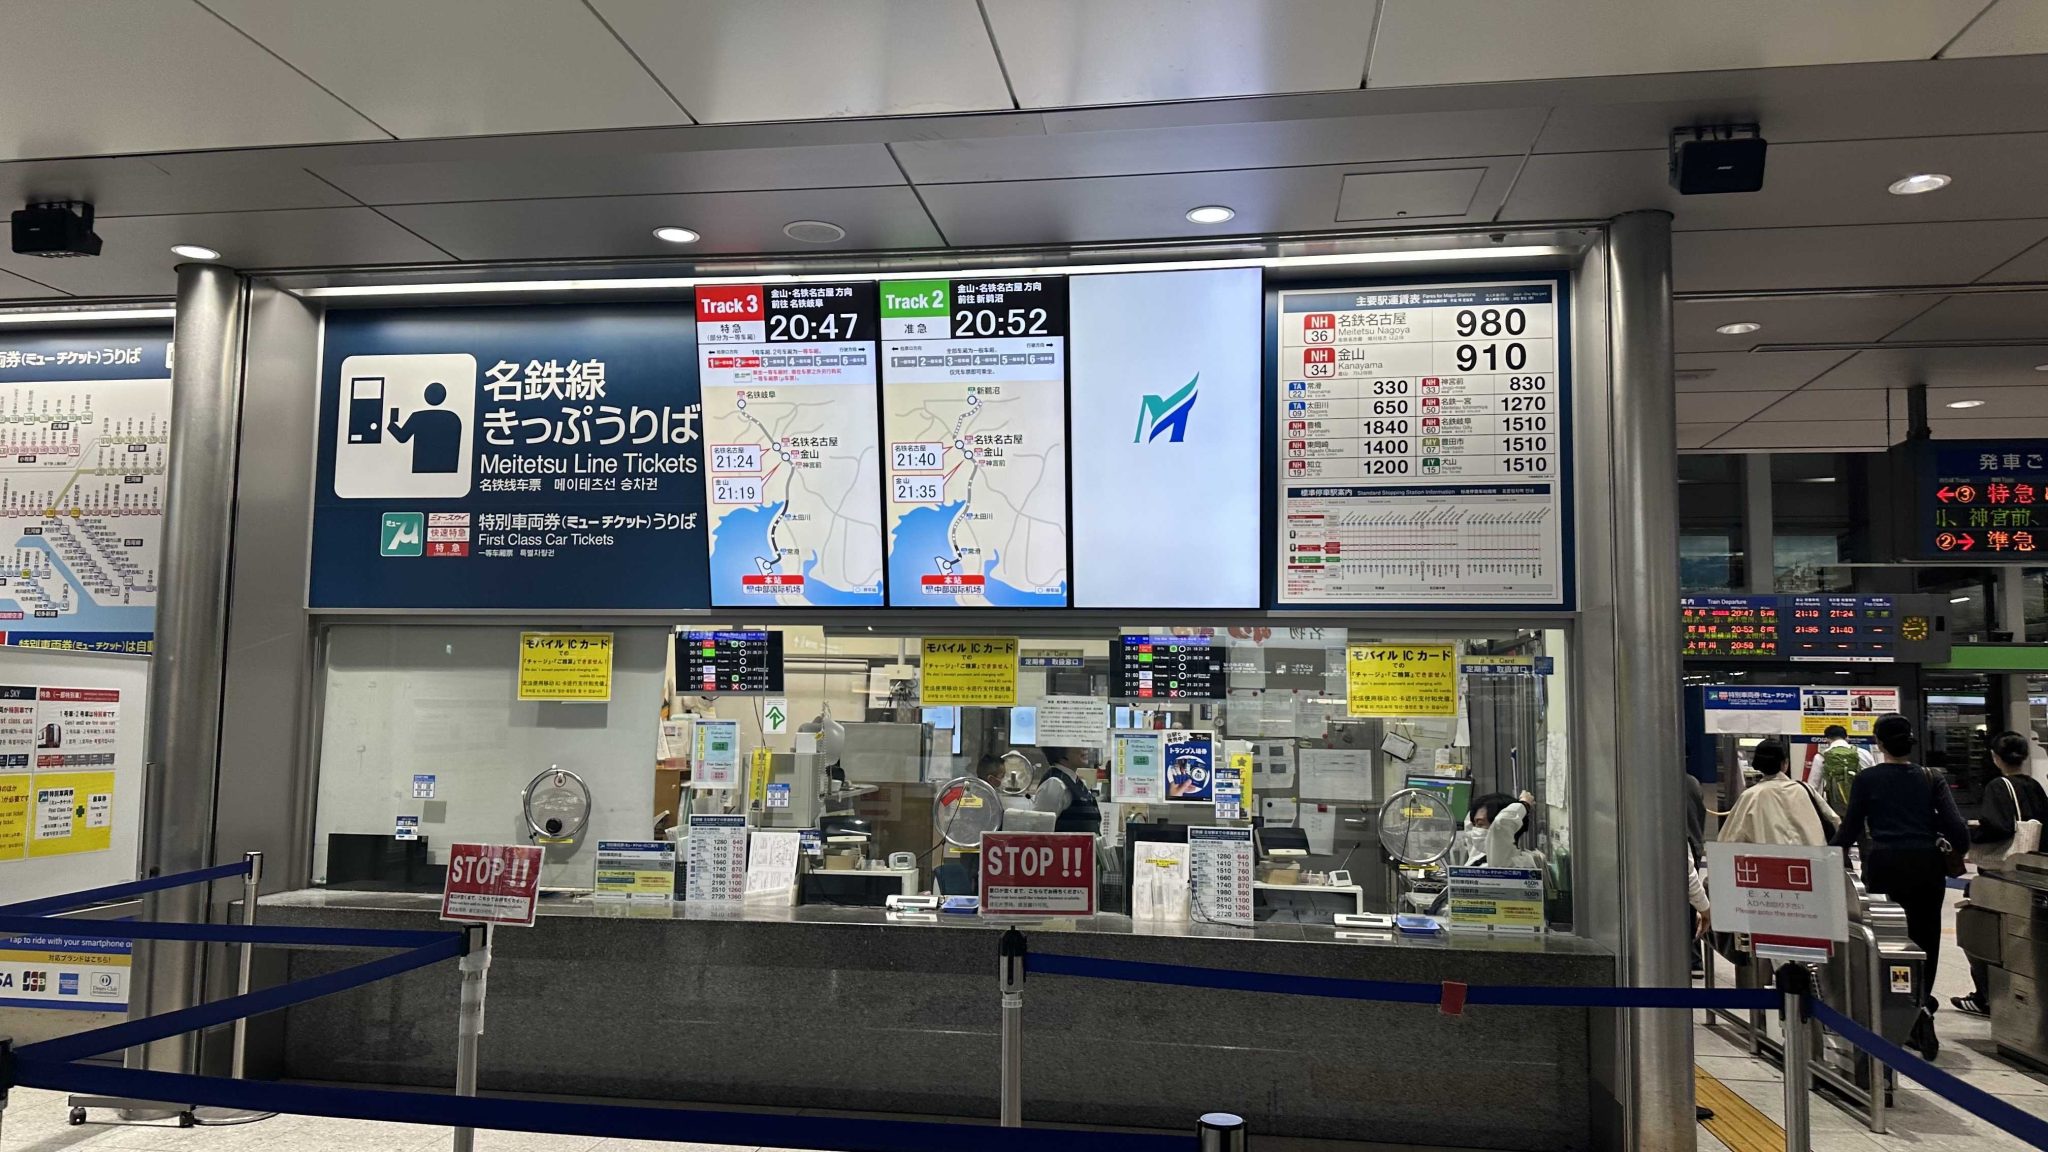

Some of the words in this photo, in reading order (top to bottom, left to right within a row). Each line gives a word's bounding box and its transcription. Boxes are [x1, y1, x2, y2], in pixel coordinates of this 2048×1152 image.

[835, 287, 852, 297] 方向
[1024, 282, 1042, 292] 方向
[701, 297, 743, 313] Track
[746, 294, 758, 313] 3
[771, 299, 789, 308] 前往
[886, 294, 929, 309] Track
[932, 290, 944, 308] 2
[957, 295, 975, 304] 前往
[1356, 294, 1420, 307] 主要駅運賃表
[955, 308, 1048, 336] 20:52
[1311, 316, 1328, 328] NH
[1338, 312, 1407, 327] 名鉄名古屋
[1457, 308, 1526, 338] 980
[720, 324, 742, 333] 特急
[770, 313, 858, 341] 20:47
[904, 323, 928, 334] 准急
[1338, 327, 1375, 336] Meitetsu
[1377, 326, 1410, 335] Nagoya
[1312, 331, 1328, 341] 36
[1311, 350, 1328, 362] NH
[1338, 347, 1365, 361] 金山
[1457, 343, 1526, 371] 910
[1312, 364, 1327, 376] 34
[1338, 361, 1383, 370] Kanayama
[483, 359, 606, 401] 名鉄線
[1510, 376, 1545, 391] 830
[1373, 380, 1408, 395] 330
[1293, 402, 1302, 410] TA
[1373, 400, 1408, 414] 650
[1501, 396, 1546, 411] 1270
[483, 403, 701, 445] きっぷうりば
[1364, 420, 1408, 434] 1840
[1503, 417, 1546, 431] 1510
[791, 437, 838, 447] 名铁名古屋
[974, 435, 1023, 445] 名铁名古屋
[1503, 437, 1547, 452] 1510
[984, 448, 1003, 457] 金山
[1364, 440, 1408, 454] 1400
[716, 455, 753, 468] 21:24
[800, 450, 819, 460] 金山
[897, 453, 936, 466] 21:40
[1980, 453, 2043, 470] 発車ご
[480, 453, 567, 474] Meitetsu
[575, 453, 617, 473] Line
[623, 453, 697, 473] Tickets
[1364, 460, 1408, 474] 1200
[1503, 457, 1547, 472] 1510
[479, 478, 541, 491] 名铁线车票
[554, 478, 616, 491] 메이테츠선
[620, 477, 658, 491] 승차권
[718, 487, 755, 500] 21:19
[898, 485, 936, 498] 21:35
[1987, 484, 2035, 503] 特急
[431, 529, 466, 537] 快速特急
[479, 534, 505, 546] First
[508, 534, 542, 546] Class
[546, 534, 567, 546] Car
[571, 534, 614, 546] Tickets
[1987, 531, 2035, 551] 準急
[765, 576, 782, 584] 本站
[944, 576, 962, 584] 本站
[755, 585, 801, 593] 中部国际机场
[934, 585, 981, 594] 中部国际机场
[1795, 610, 1819, 618] 21:19
[1830, 610, 1853, 618] 21:24
[1830, 626, 1853, 634] 21:40
[526, 639, 564, 649] モバイル
[568, 639, 577, 649] IC
[580, 639, 608, 649] カード
[926, 643, 967, 653] モバイル
[971, 643, 980, 653] IC
[983, 643, 1013, 653] カード
[1353, 650, 1398, 661] モバイル
[1403, 650, 1413, 661] IC
[1417, 650, 1451, 661] カード
[987, 846, 1053, 877] STOP
[1062, 847, 1082, 877] !!
[452, 855, 505, 885] STOP
[509, 858, 530, 887] !!
[1737, 860, 1809, 885] 出口
[1749, 891, 1801, 899] EXIT
[1787, 911, 1818, 919] entrance
[32, 936, 46, 944] ride
[64, 939, 80, 948] your
[81, 939, 124, 948] smartphone
